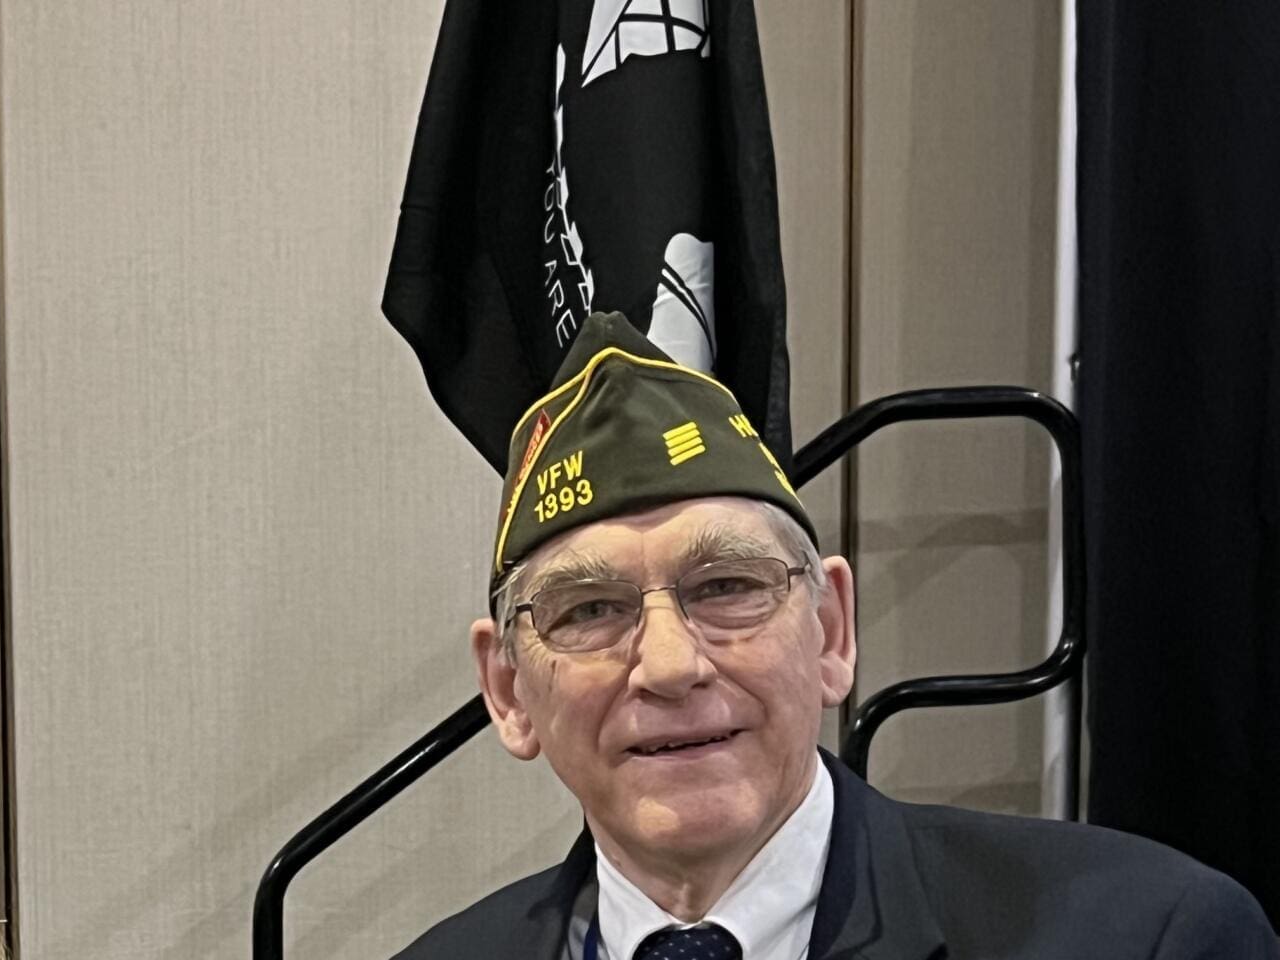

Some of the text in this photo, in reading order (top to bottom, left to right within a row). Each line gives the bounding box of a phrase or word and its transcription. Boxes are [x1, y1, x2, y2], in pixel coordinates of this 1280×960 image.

[544, 154, 577, 348] YOU ARE
[536, 450, 582, 495] VFW
[534, 479, 593, 523] 1393
